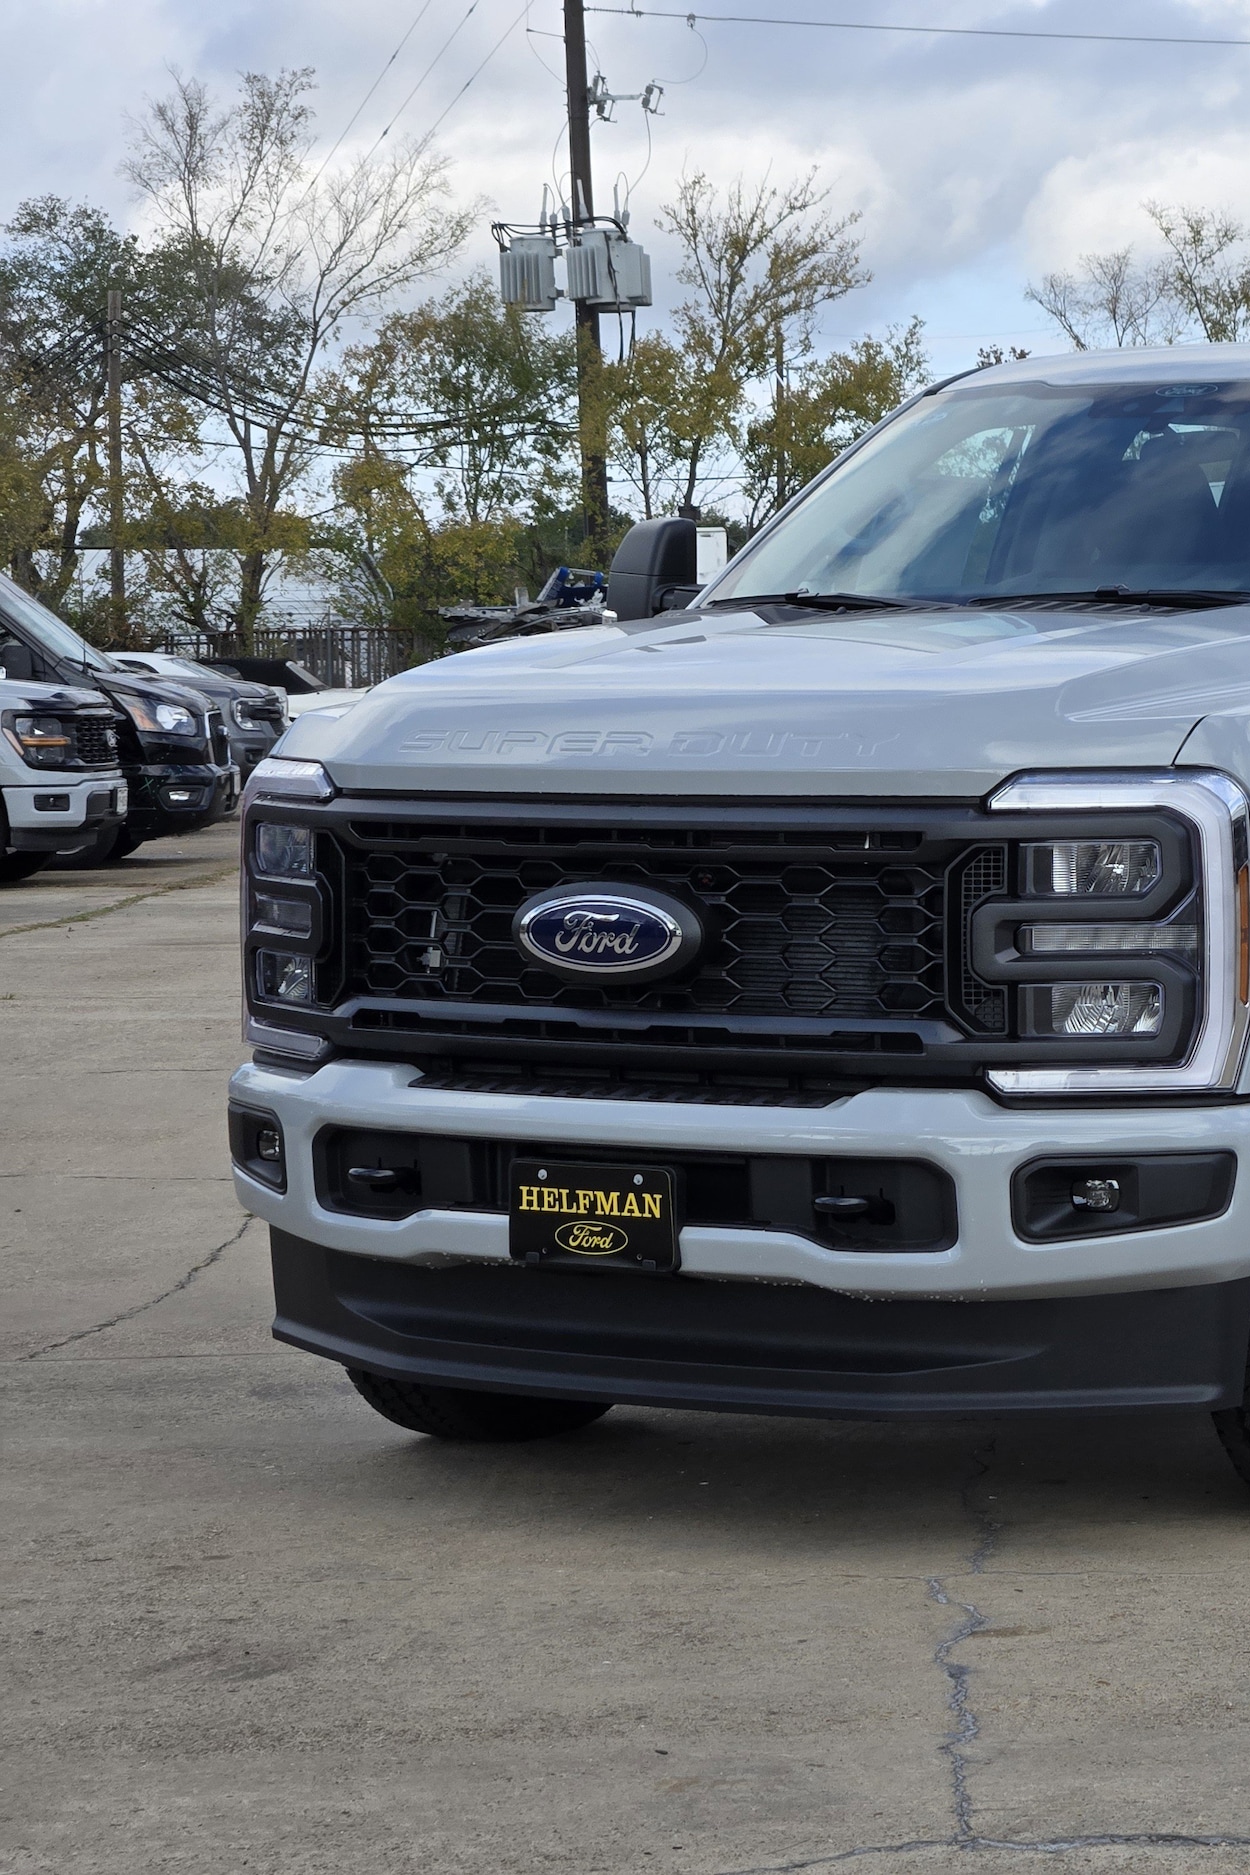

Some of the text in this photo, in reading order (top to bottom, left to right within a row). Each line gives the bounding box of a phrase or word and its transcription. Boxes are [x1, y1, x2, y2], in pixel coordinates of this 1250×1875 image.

[399, 728, 900, 758] SUPER DUTY
[555, 910, 642, 955] Ford
[518, 1185, 663, 1219] HELFMAN
[568, 1224, 614, 1249] Ford
